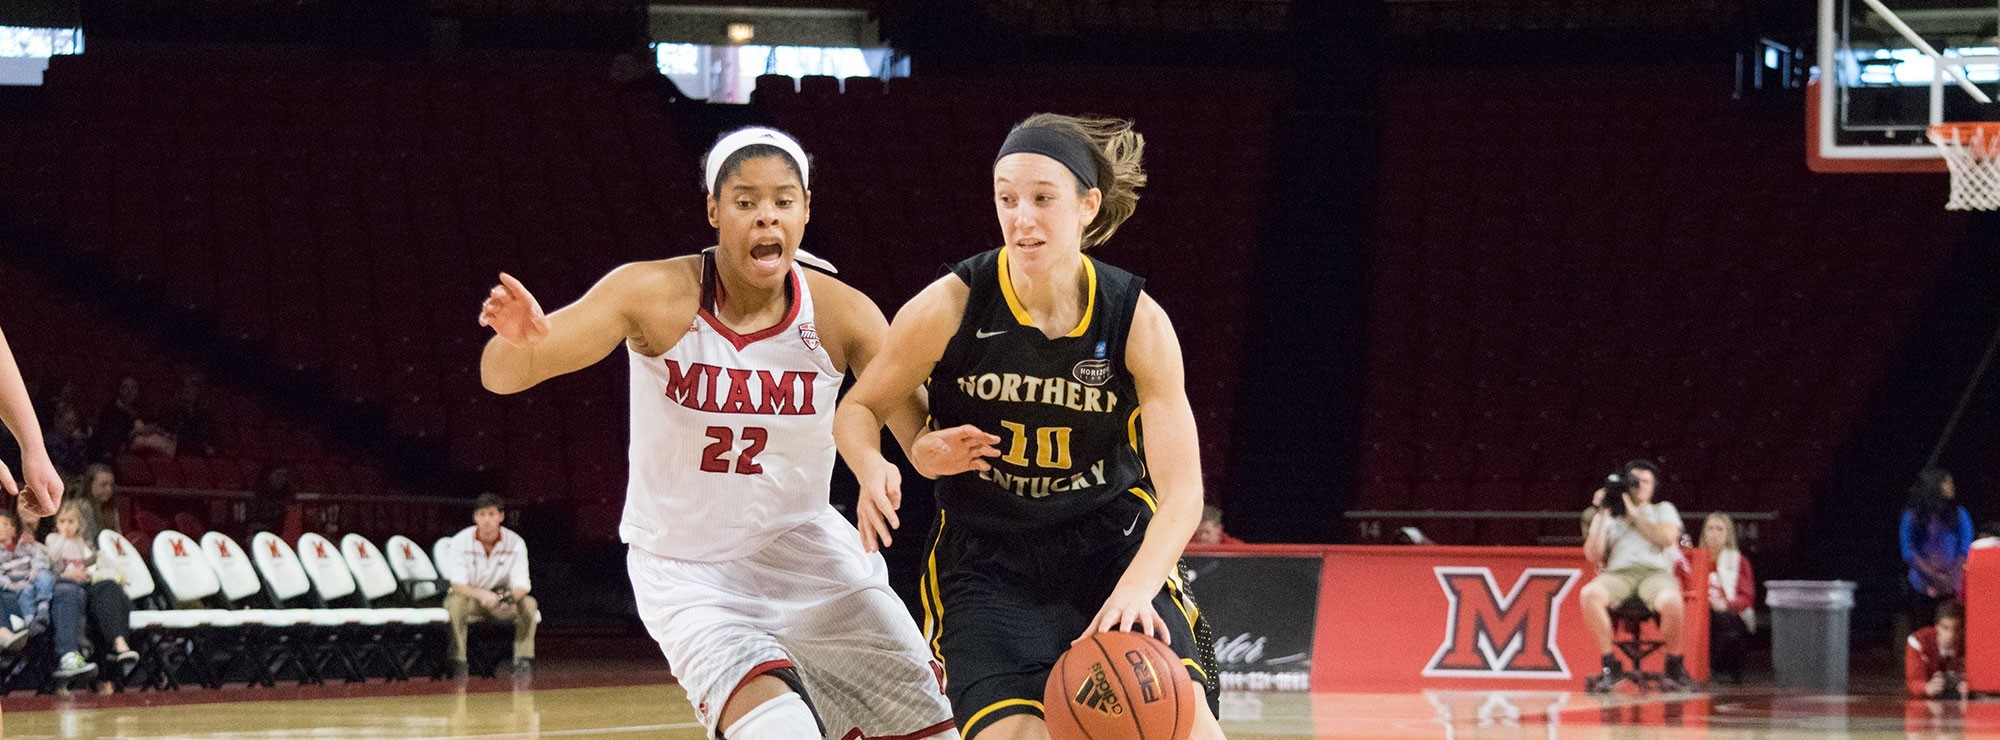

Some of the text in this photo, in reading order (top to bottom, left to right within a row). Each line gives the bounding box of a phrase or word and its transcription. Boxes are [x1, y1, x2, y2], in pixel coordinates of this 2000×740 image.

[664, 358, 819, 416] MIAMI
[699, 425, 769, 475] 22
[1000, 420, 1073, 470] 10
[979, 459, 1107, 499] NTUCKY
[1421, 566, 1582, 680] M
[1092, 662, 1124, 716] adidas
[1125, 650, 1160, 704] PRO
